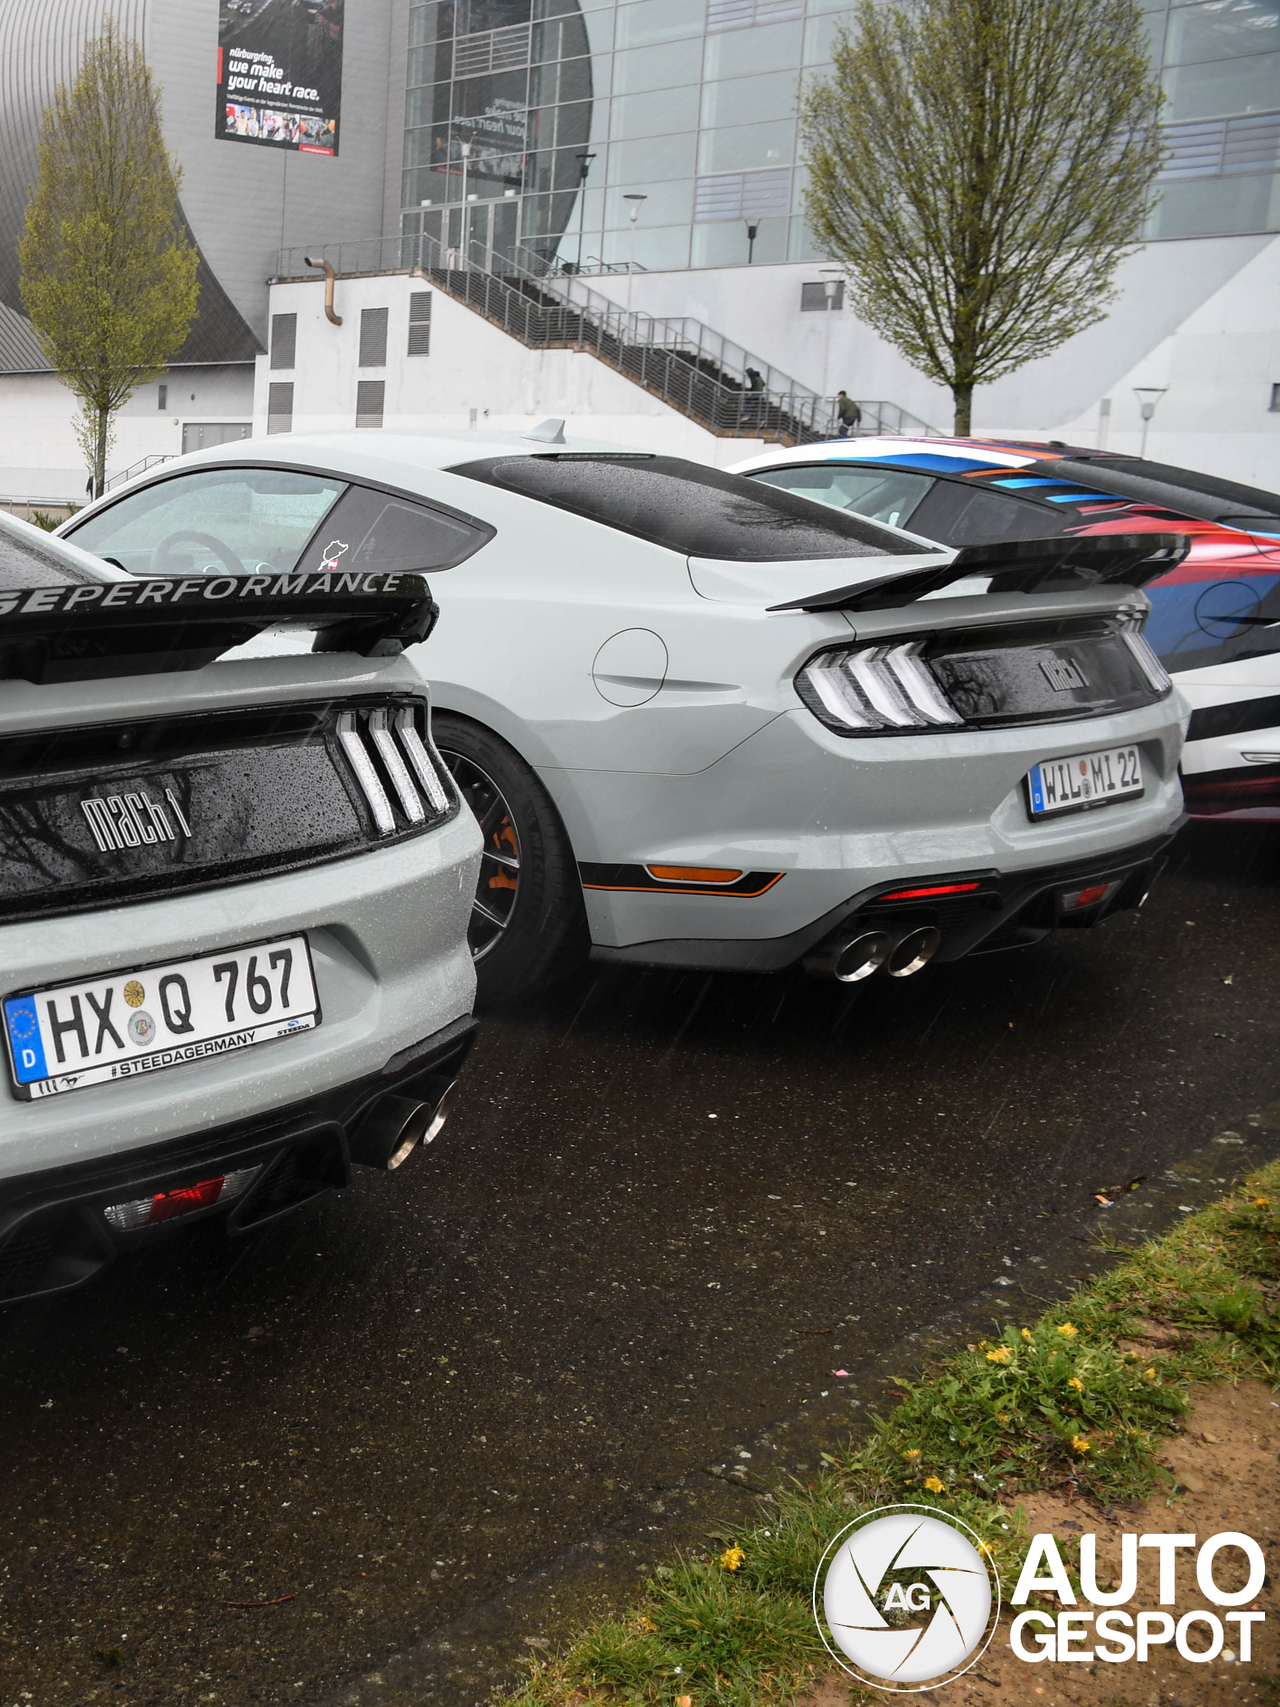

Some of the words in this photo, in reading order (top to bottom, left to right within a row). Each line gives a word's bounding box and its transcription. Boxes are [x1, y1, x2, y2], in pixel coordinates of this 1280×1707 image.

[229, 48, 274, 64] nürburgring.
[228, 60, 249, 74] we
[250, 64, 283, 79] make
[227, 75, 258, 90] your
[258, 77, 292, 95] heart
[292, 86, 320, 101] race.
[1043, 763, 1081, 804] WIL
[1090, 755, 1116, 794] MI
[1118, 750, 1140, 788] 22
[47, 987, 125, 1063] HX
[159, 973, 195, 1034] Q
[212, 948, 293, 1022] 767
[277, 1023, 310, 1036] STEEDA
[23, 1048, 36, 1068] D
[111, 1031, 256, 1078] #STEEDAGERMANY
